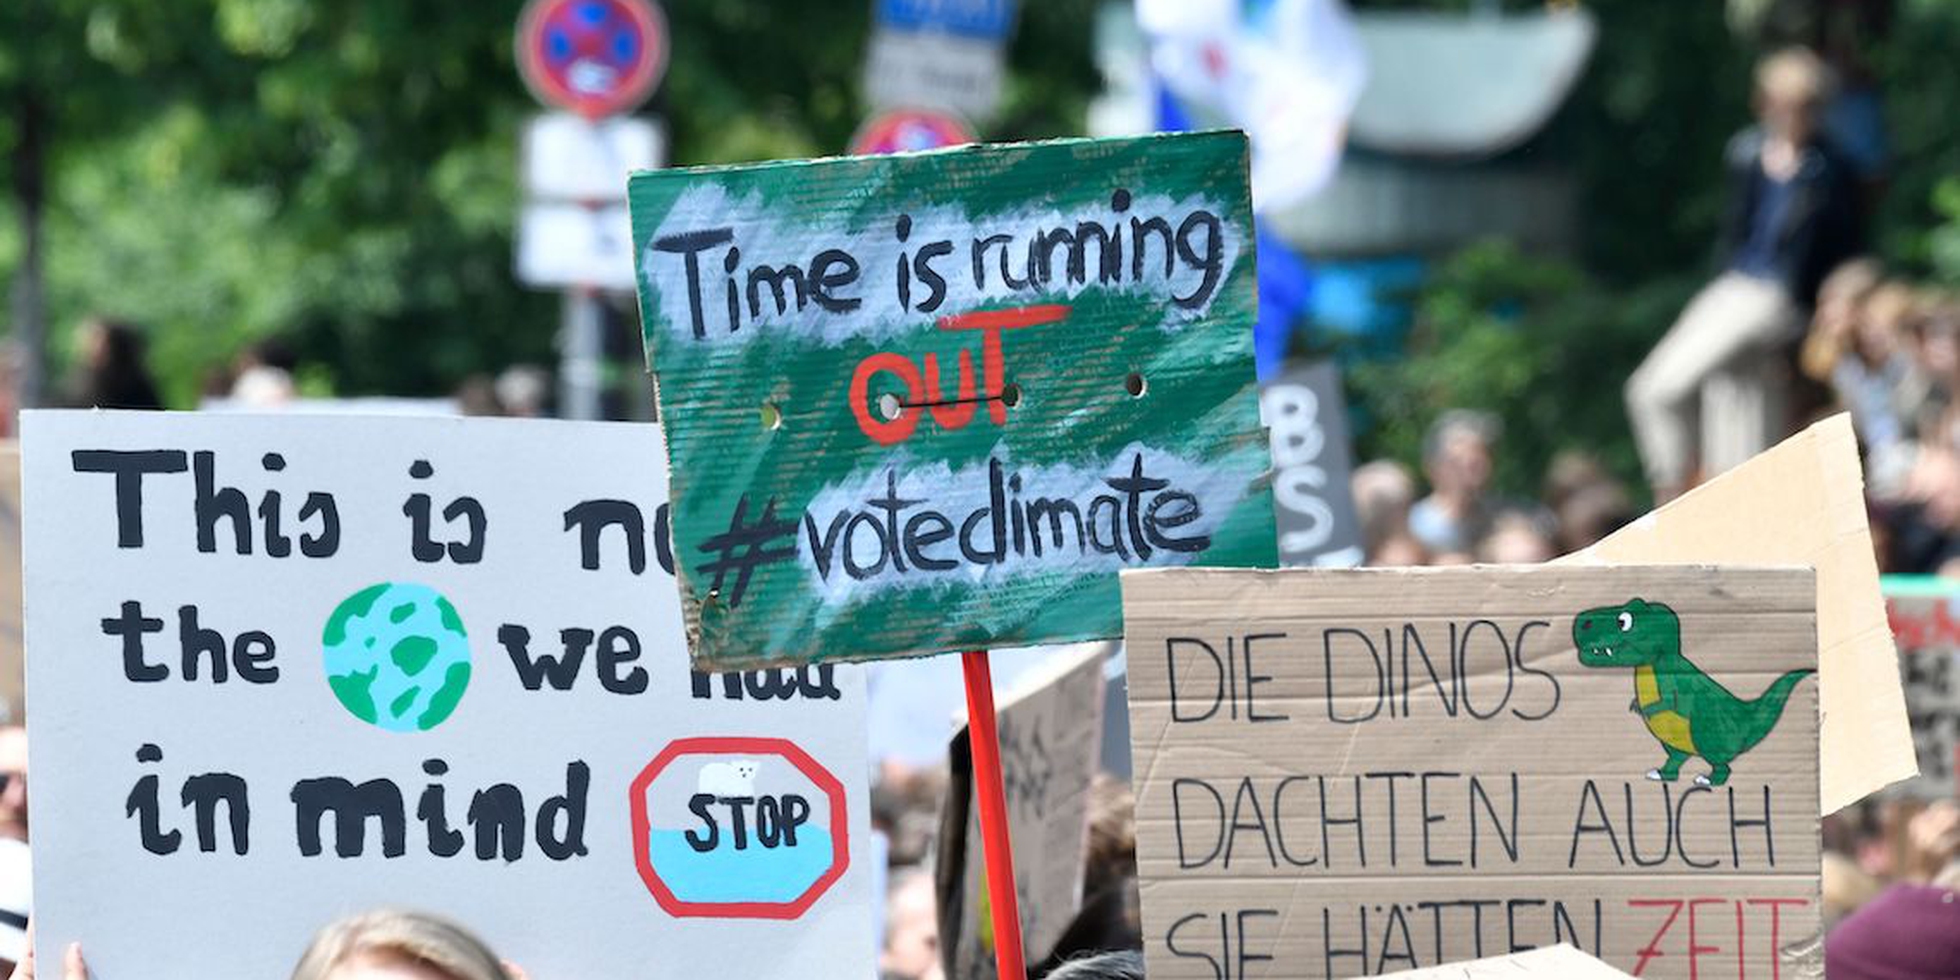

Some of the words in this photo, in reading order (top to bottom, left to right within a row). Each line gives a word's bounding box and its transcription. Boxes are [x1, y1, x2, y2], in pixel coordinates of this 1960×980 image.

[652, 228, 862, 339] Time
[896, 213, 953, 313] is
[971, 188, 1225, 310] running
[849, 304, 1073, 446] OUT
[71, 449, 341, 558] This
[402, 460, 487, 564] is
[101, 600, 280, 683] the
[498, 624, 649, 695] we
[1165, 633, 1289, 724] DIE
[1323, 619, 1562, 724] DINOS
[126, 743, 250, 856] in
[290, 759, 590, 862] mind
[685, 793, 811, 852] STOP
[1172, 772, 1520, 870] DACHTEN
[1569, 780, 1777, 870] AUCH
[1627, 898, 1809, 980] ZEIT
